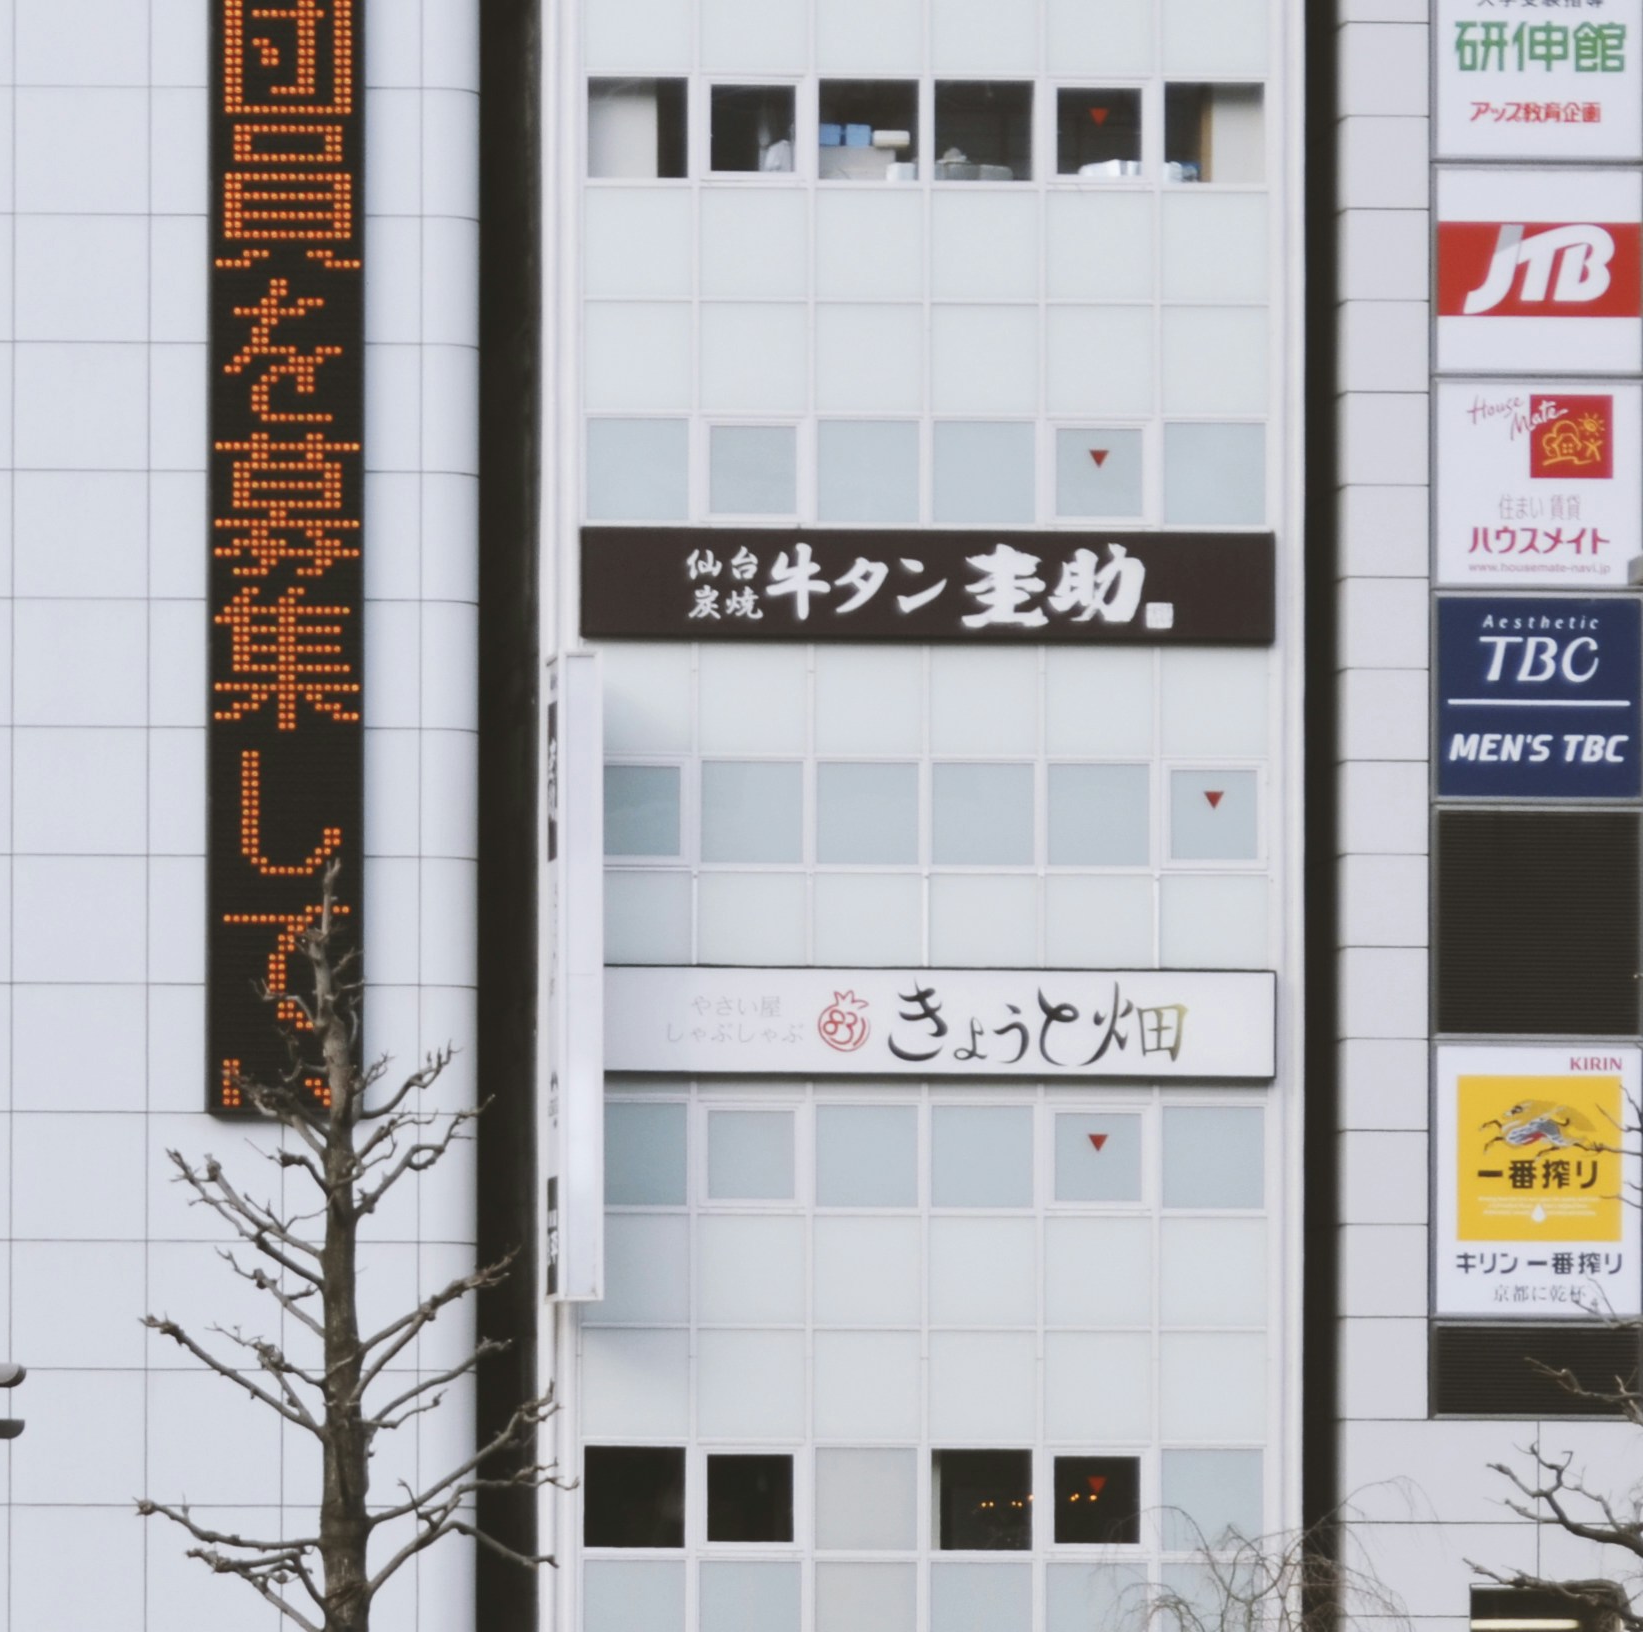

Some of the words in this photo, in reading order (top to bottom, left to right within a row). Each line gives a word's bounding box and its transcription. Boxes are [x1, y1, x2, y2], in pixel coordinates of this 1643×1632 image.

[1453, 20, 1627, 73] 研伸館
[1463, 223, 1616, 315] JTB
[1467, 395, 1525, 424] House
[1510, 399, 1569, 441] Mate
[1499, 495, 1544, 520] 住まい
[1550, 496, 1581, 520] 賃貸
[213, 0, 362, 1107] 団員を募集して
[1468, 526, 1610, 555] ハウスメイト
[686, 548, 759, 581] 仙台
[1468, 562, 1611, 575] www.housemate-navi.jp
[766, 543, 948, 620] 牛タン
[687, 585, 763, 621] 炭焼
[1483, 615, 1599, 630] Aesthetic
[1479, 637, 1599, 682] TBC
[1449, 734, 1553, 763] MEN'S
[1562, 735, 1629, 763] TBC
[691, 996, 782, 1018] やさい屋
[666, 1023, 805, 1044] しゃぶしゃぶ
[888, 978, 1189, 1067] きょうと畑
[1570, 1057, 1622, 1071] KIRIN
[1478, 1160, 1598, 1189] 一番搾り
[1456, 1253, 1518, 1275] キリン
[1528, 1252, 1622, 1275] 一番搾り
[1494, 1285, 1586, 1302] 京都に乾杯
